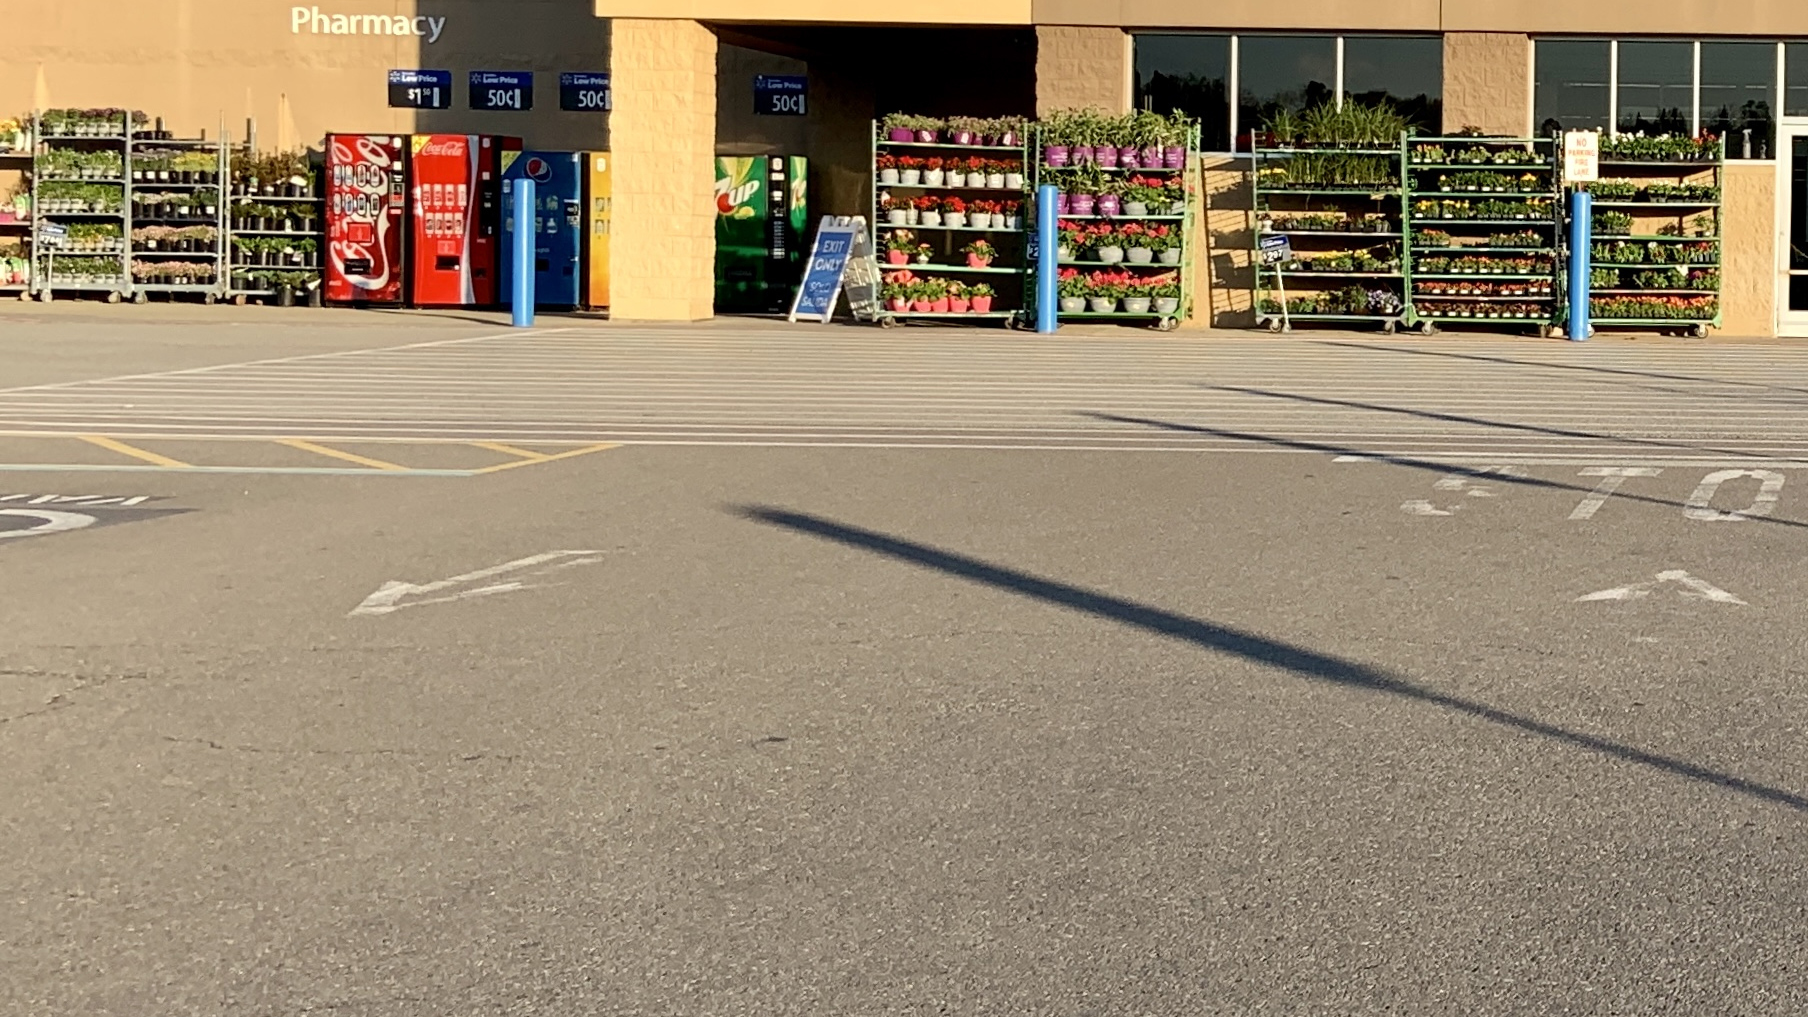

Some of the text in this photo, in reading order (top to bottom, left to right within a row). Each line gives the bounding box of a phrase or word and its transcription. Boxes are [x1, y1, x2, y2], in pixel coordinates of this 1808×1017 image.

[291, 6, 445, 43] Pharmacy
[419, 75, 438, 83] Price
[487, 89, 514, 107] 50¢
[577, 90, 605, 108] 50¢
[771, 94, 798, 112] 50¢
[421, 141, 466, 157] Coca-Cola
[1577, 138, 1587, 147] NO
[822, 240, 846, 253] EXIT
[814, 257, 843, 271] ONLY
